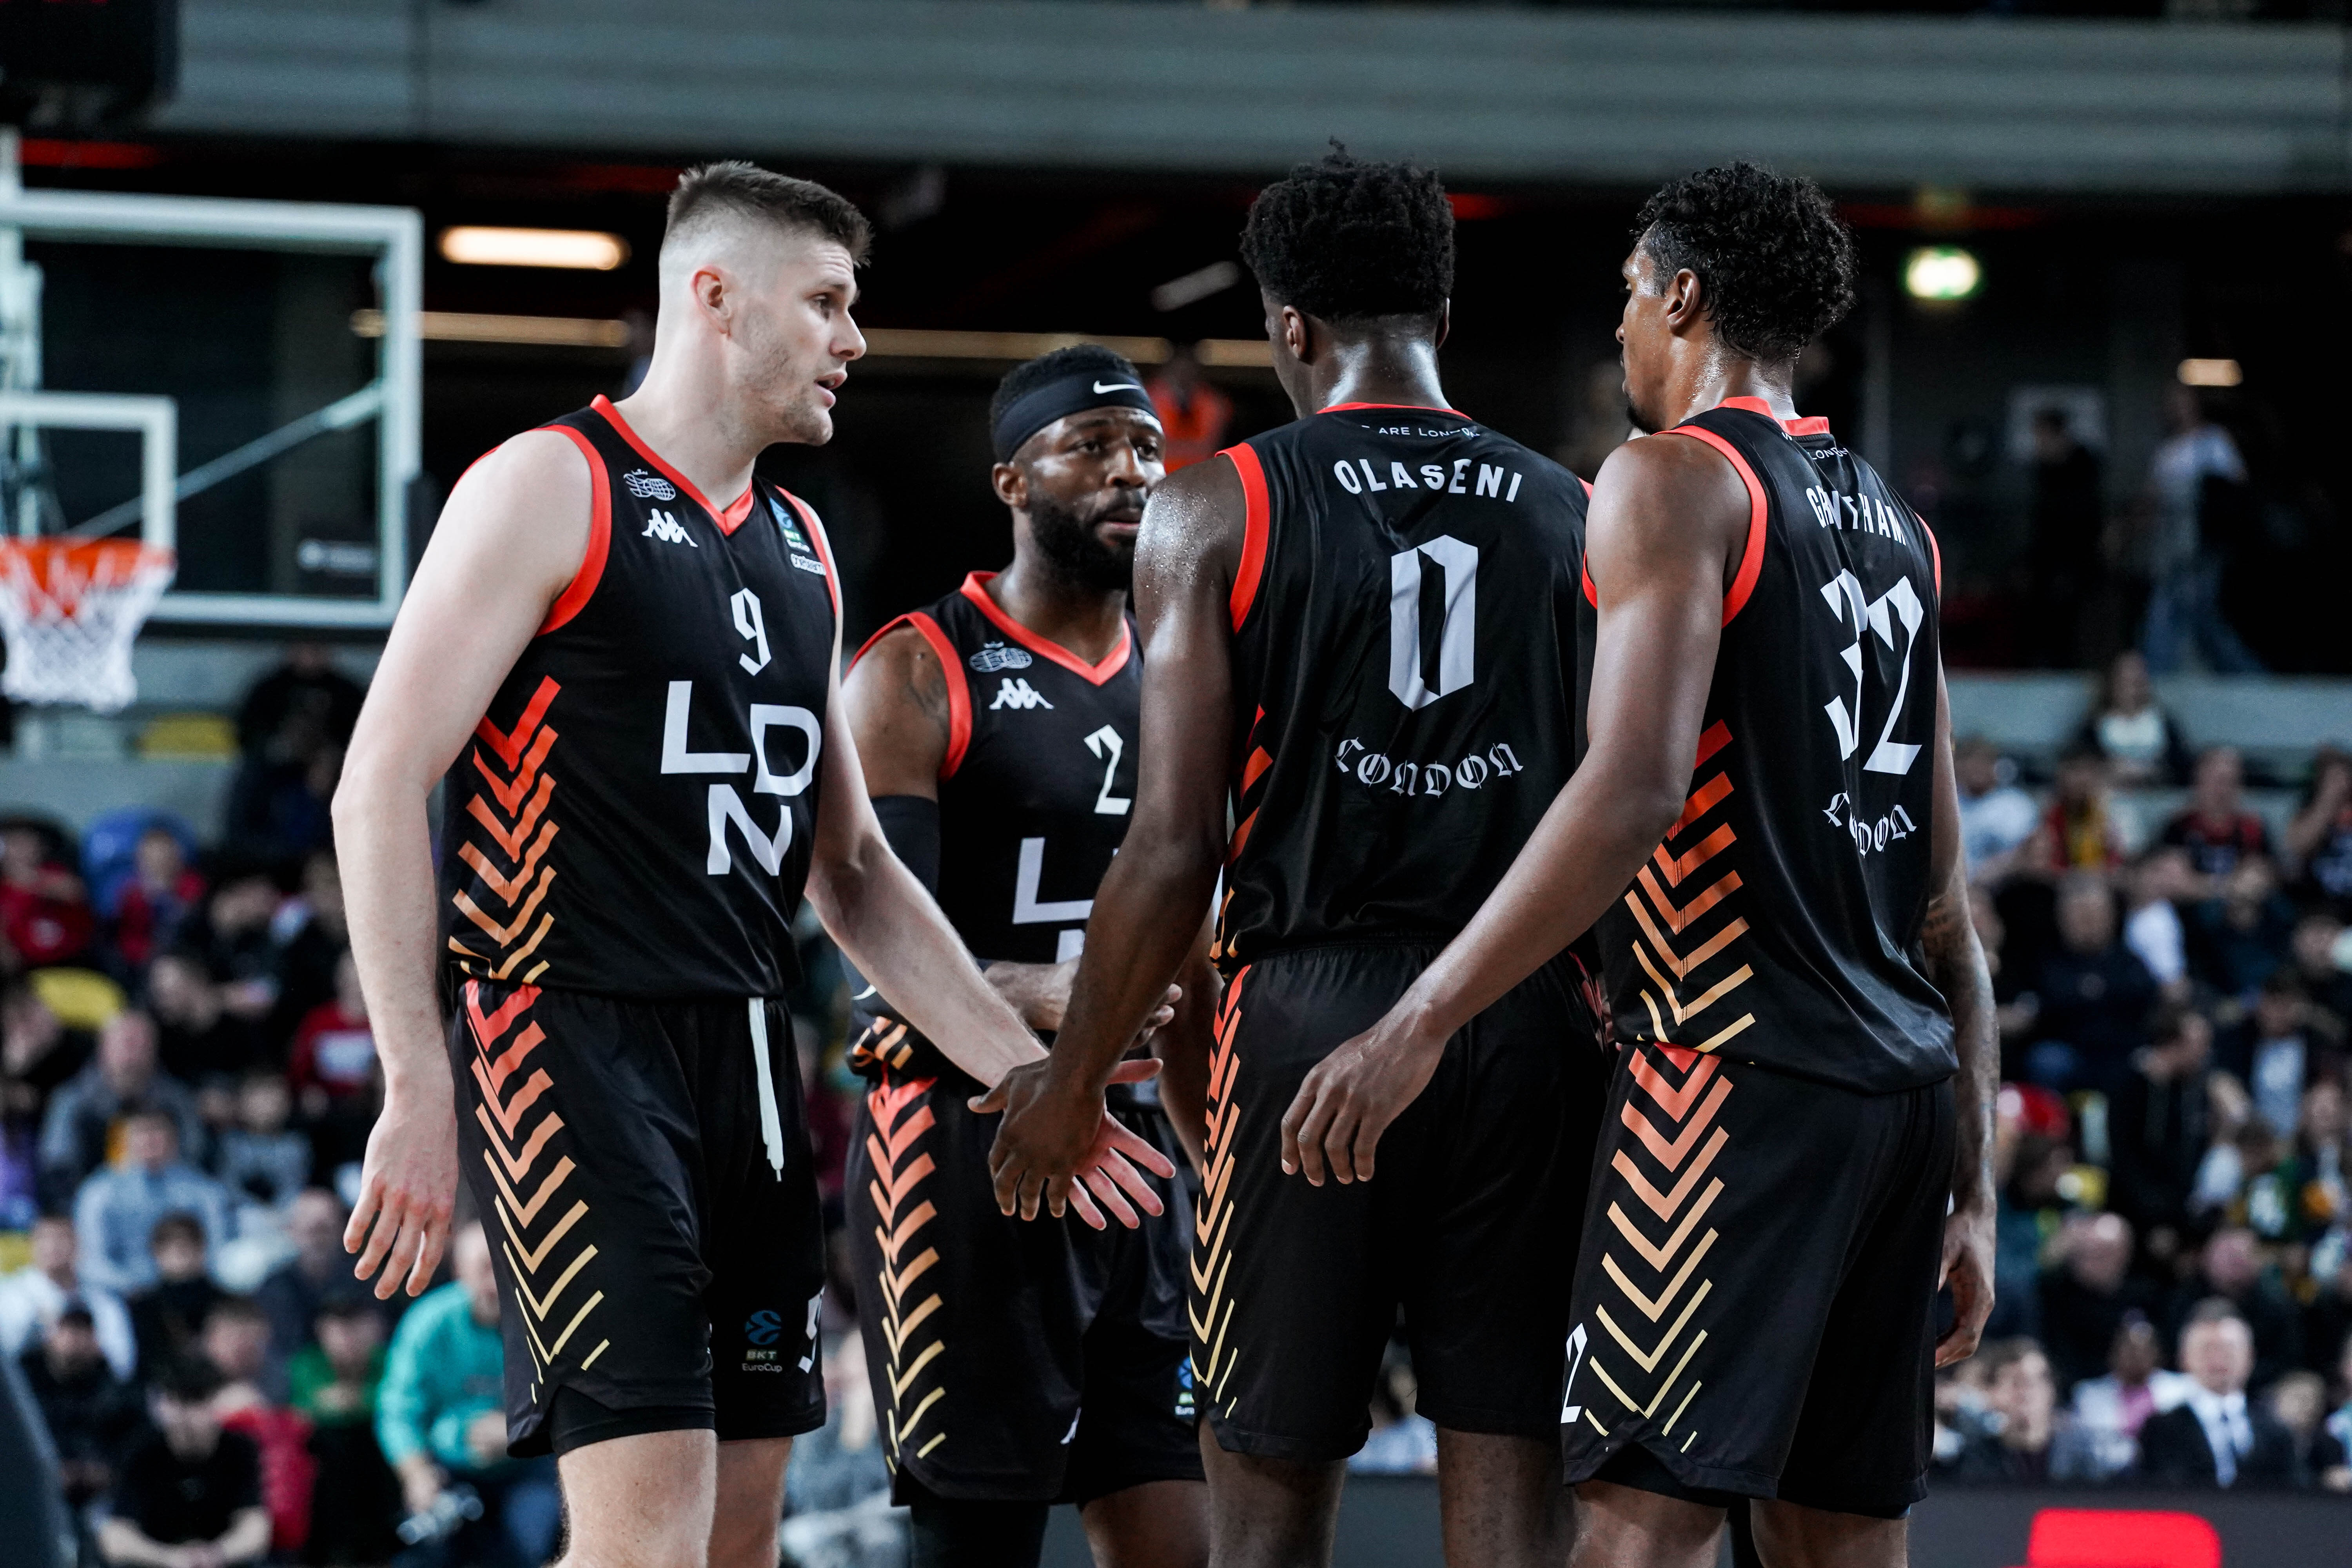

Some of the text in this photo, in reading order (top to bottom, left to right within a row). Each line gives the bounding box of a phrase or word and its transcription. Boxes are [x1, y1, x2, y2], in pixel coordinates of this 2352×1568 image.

[1379, 426, 1410, 436] ARE
[1334, 458, 1523, 503] OLASENI
[730, 587, 772, 676] 9
[1388, 534, 1479, 713] 0
[1820, 568, 1924, 775] 32
[1083, 724, 1132, 815] 2
[741, 1363, 783, 1373] EuroCup
[746, 1350, 777, 1360] BKT
